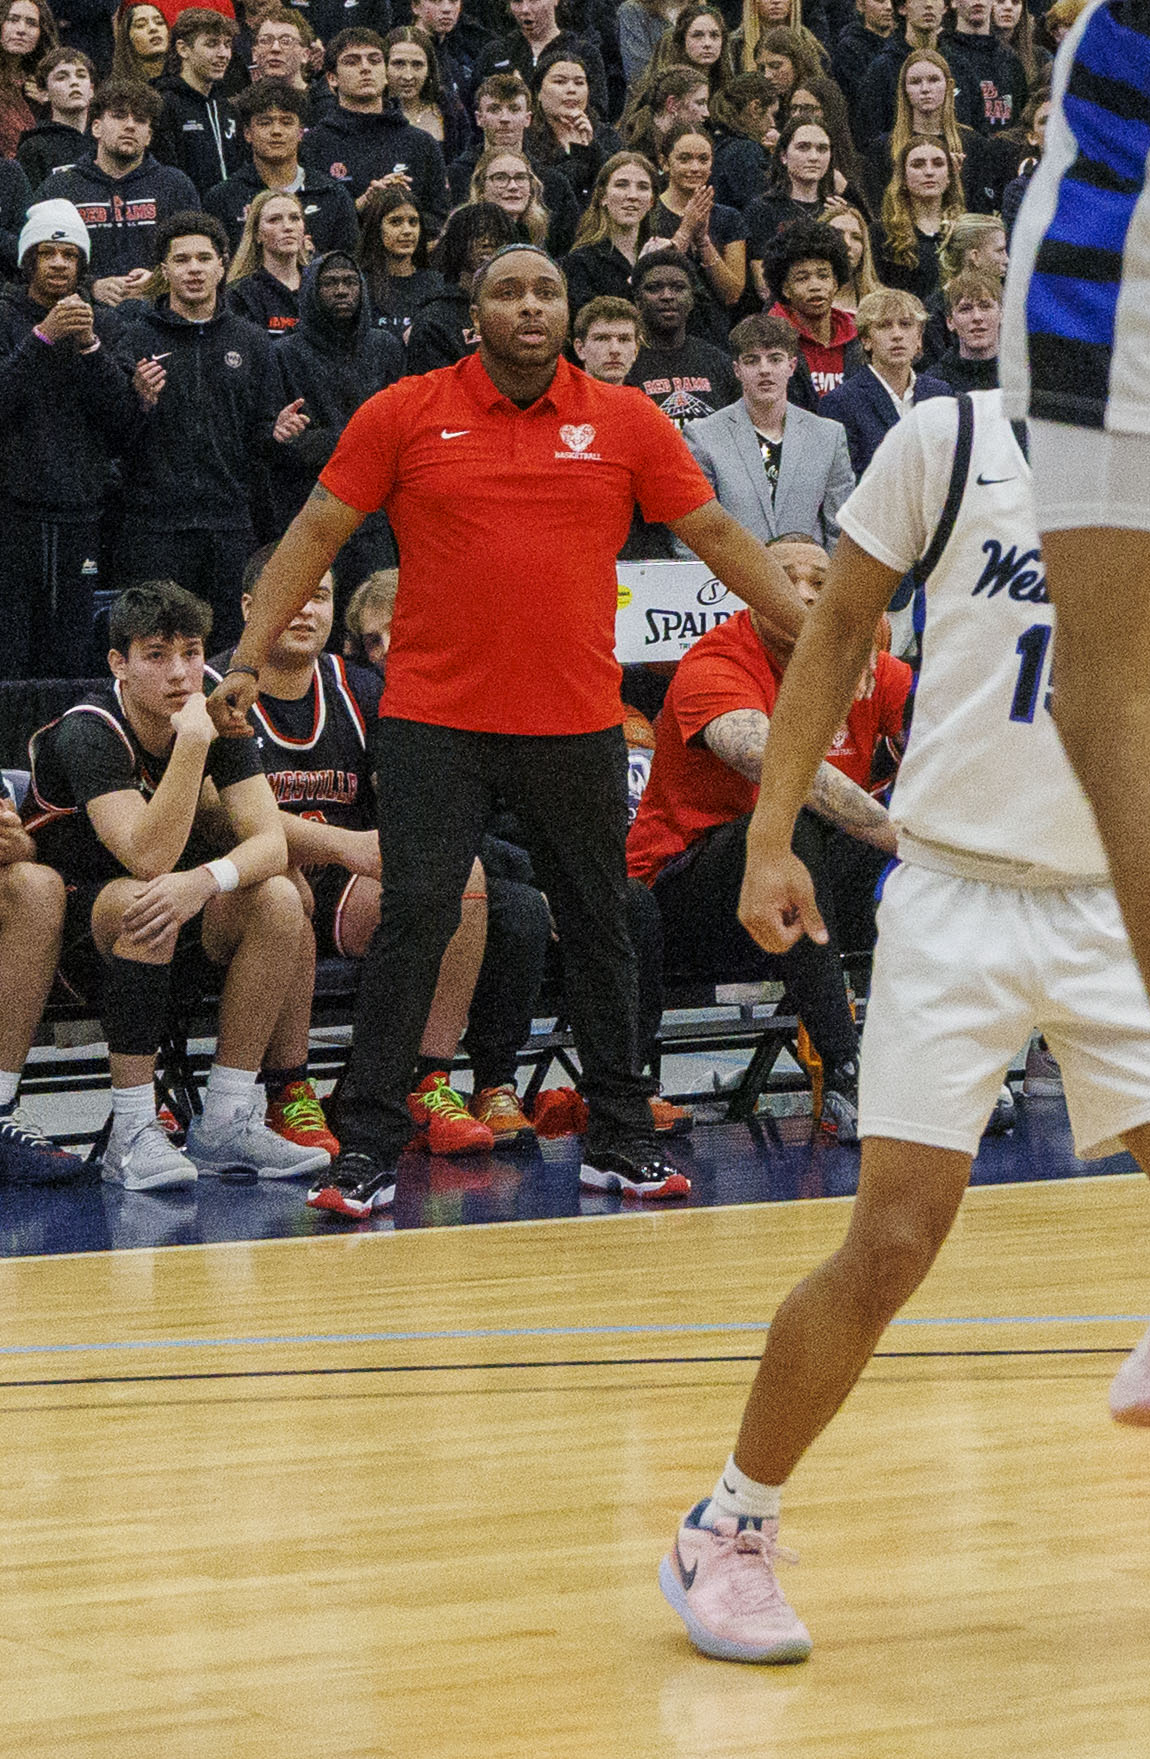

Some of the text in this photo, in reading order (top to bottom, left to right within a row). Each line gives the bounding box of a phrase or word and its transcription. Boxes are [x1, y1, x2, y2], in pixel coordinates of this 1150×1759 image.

[643, 376, 712, 396] RED RAMS
[1009, 623, 1054, 725] 1
[266, 770, 358, 804] MESVILLE
